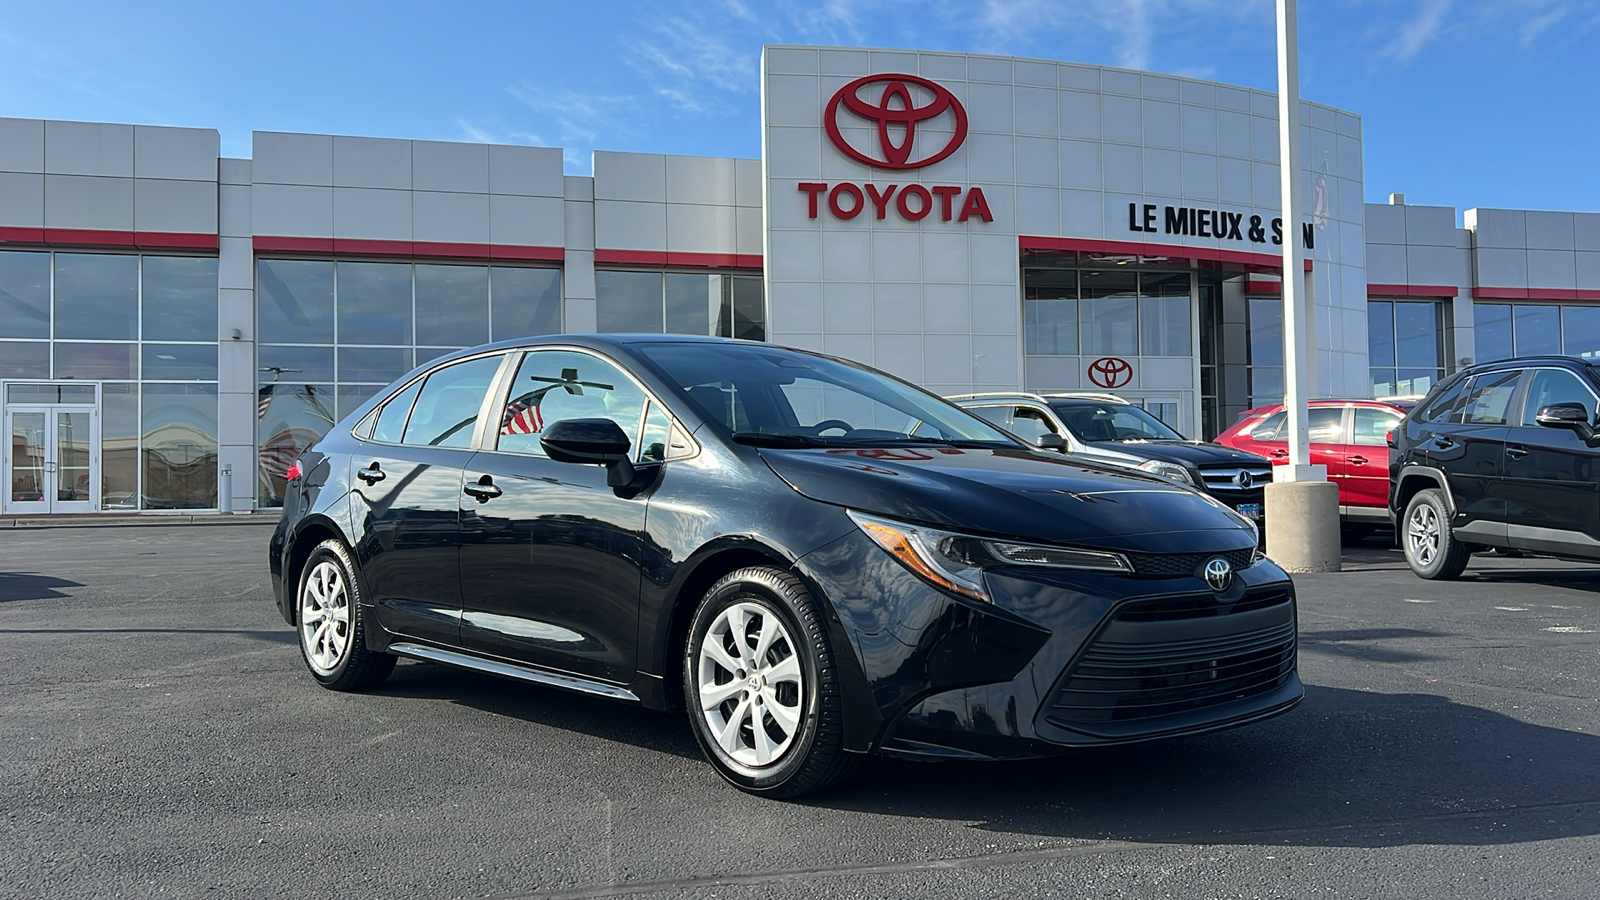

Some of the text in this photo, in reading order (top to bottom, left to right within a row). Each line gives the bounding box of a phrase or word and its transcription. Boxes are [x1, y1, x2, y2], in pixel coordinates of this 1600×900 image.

[798, 182, 994, 223] TOYOTA
[1129, 203, 1314, 249] LE MIEUX & SN
